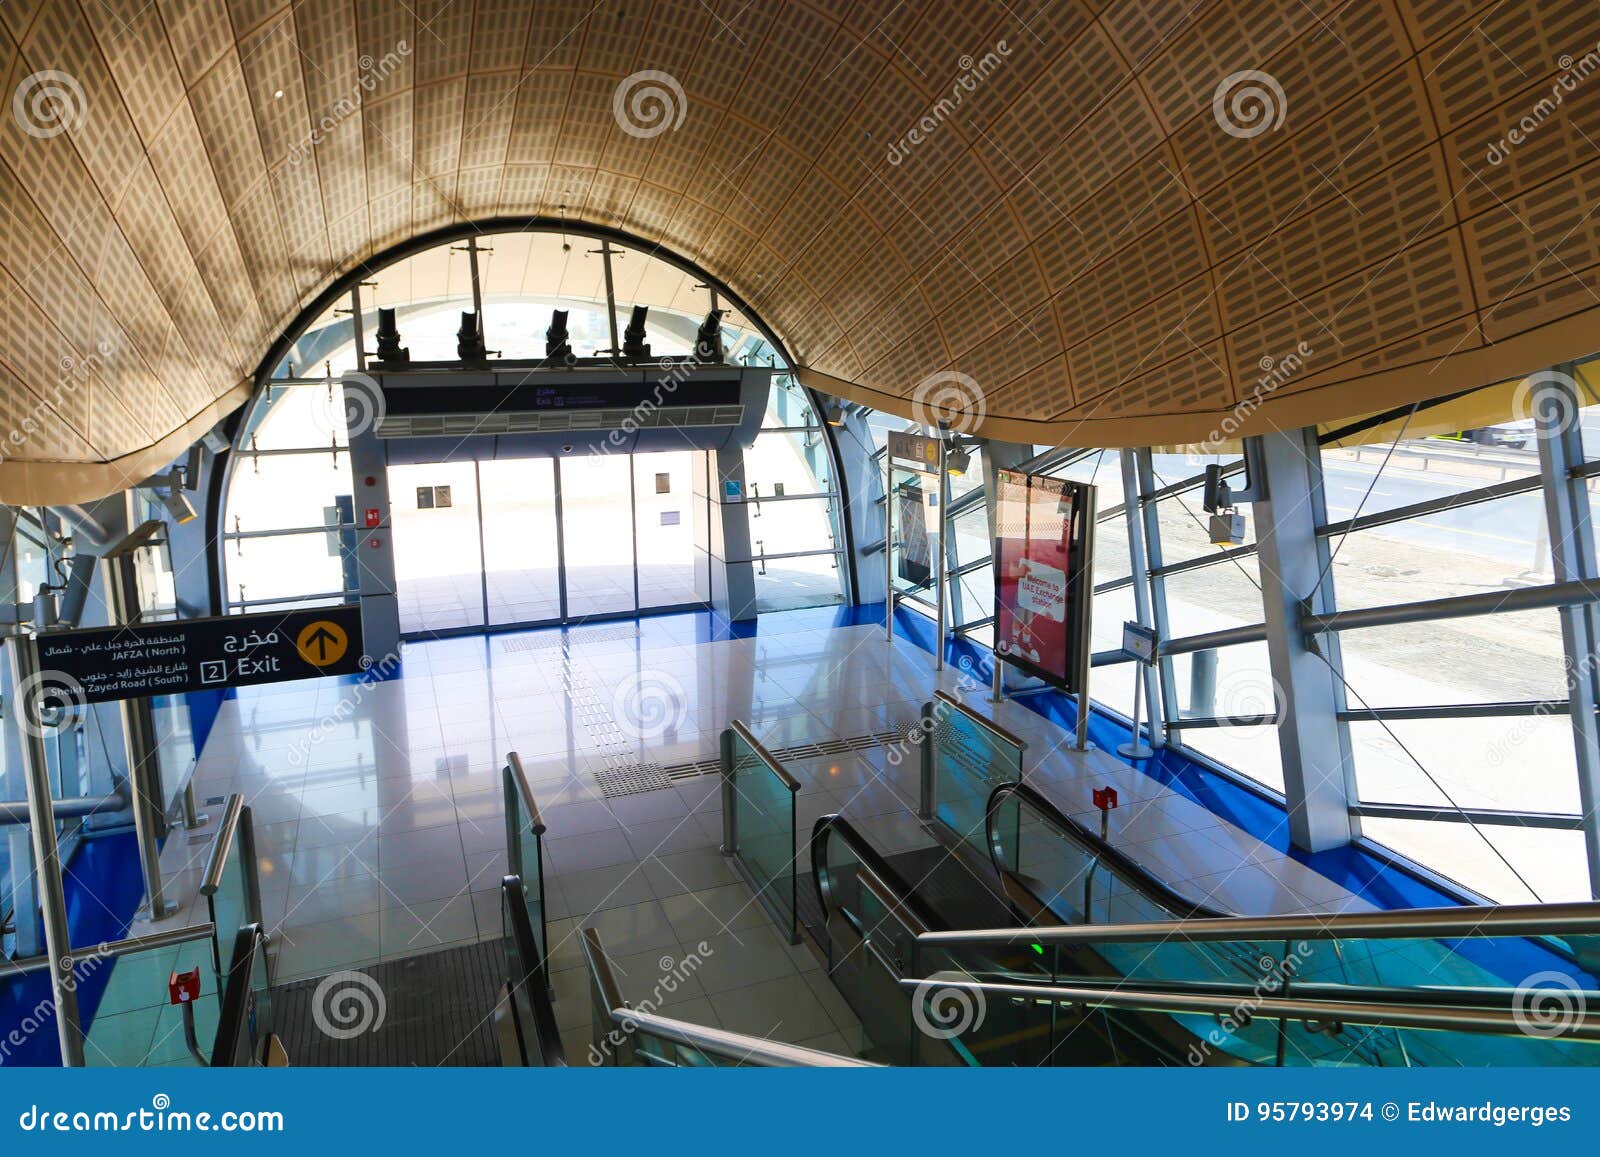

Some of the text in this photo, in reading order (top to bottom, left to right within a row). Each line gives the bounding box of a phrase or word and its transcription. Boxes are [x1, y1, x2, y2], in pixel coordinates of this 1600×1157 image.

[1023, 581, 1034, 593] UAE
[104, 640, 122, 651] جبل
[125, 638, 145, 650] الحرة
[147, 634, 185, 647] المنطقة
[223, 629, 279, 653] مخرج
[44, 644, 73, 657] شمال
[81, 643, 101, 654] علي
[111, 650, 143, 661] JAFZA
[134, 664, 163, 678] الشيخ
[164, 661, 188, 674] شارع
[237, 654, 281, 676] Exit
[80, 672, 107, 683] جنوب
[50, 685, 85, 697] Sheikh
[88, 681, 118, 696] Zayed
[121, 677, 145, 689] Road
